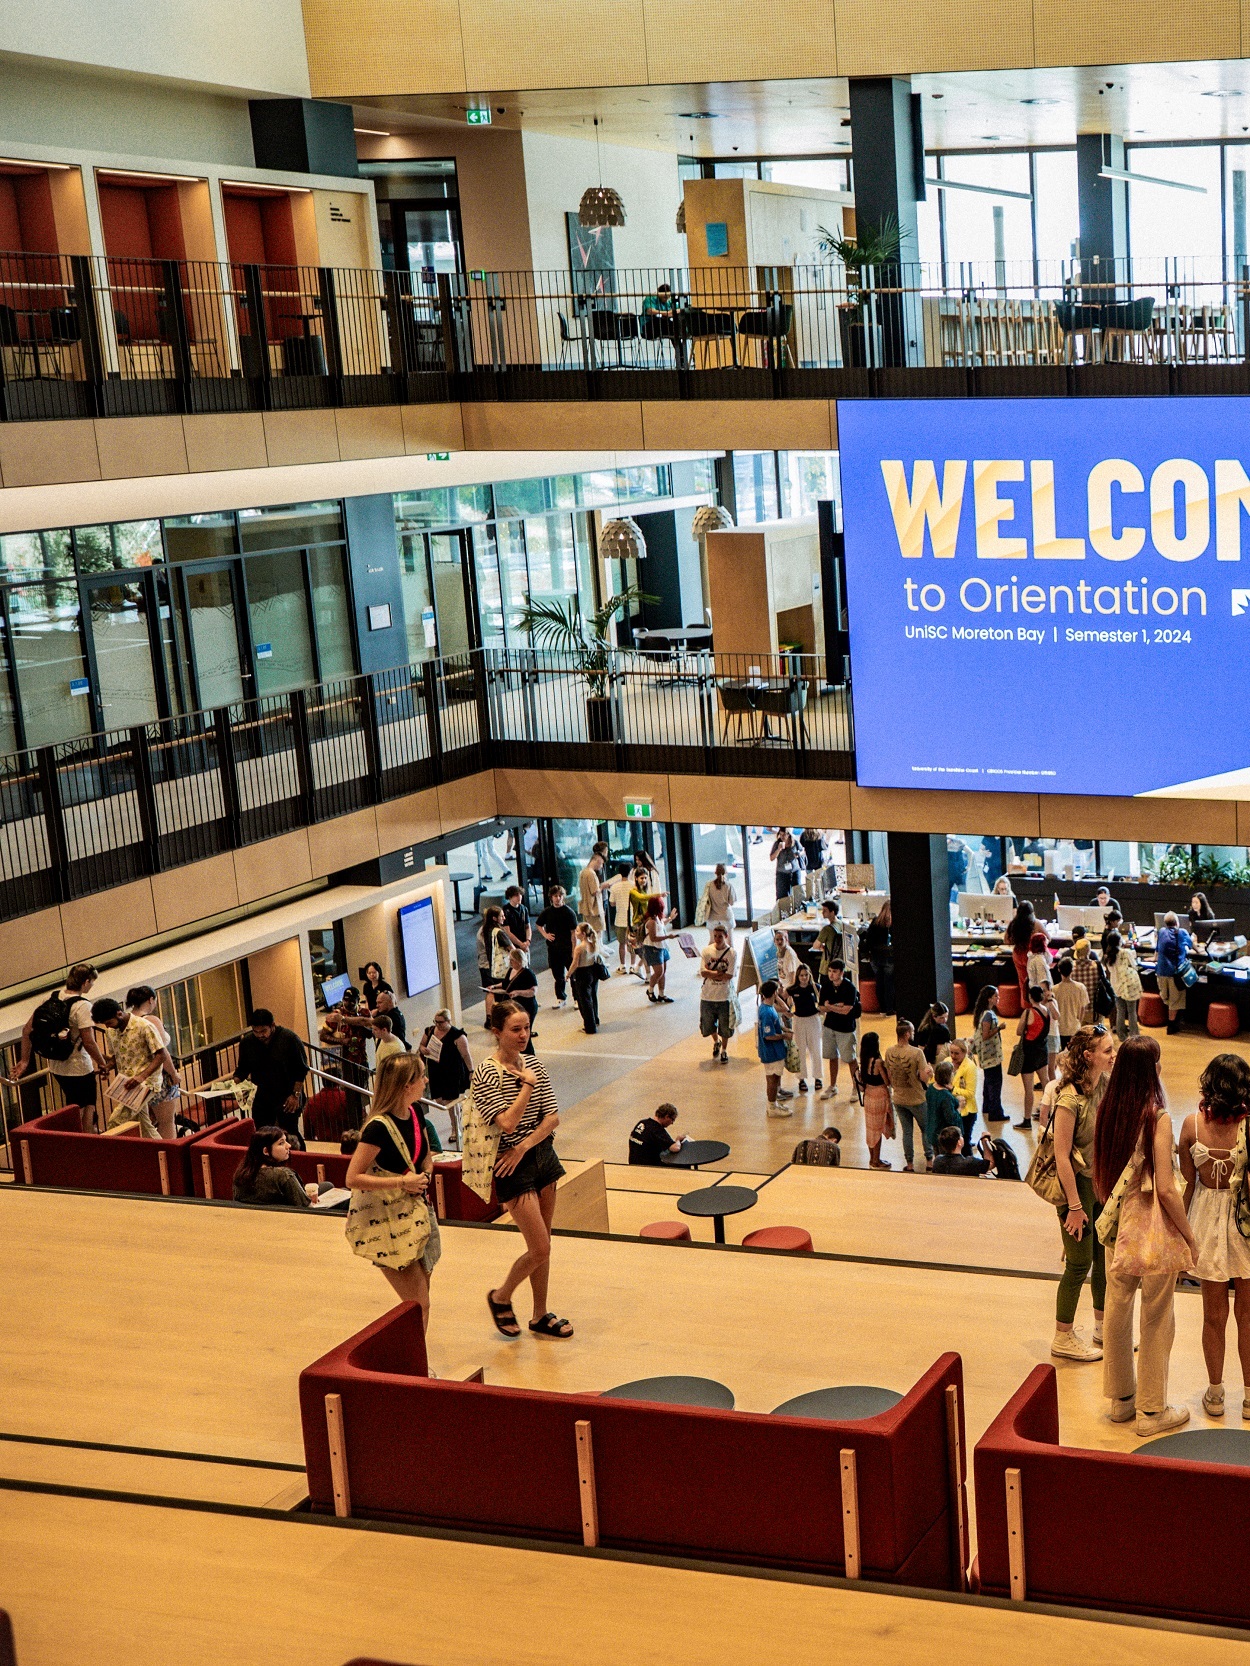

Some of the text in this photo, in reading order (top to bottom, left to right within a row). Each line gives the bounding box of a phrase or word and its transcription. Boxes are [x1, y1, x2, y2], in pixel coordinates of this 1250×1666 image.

[904, 575, 1207, 616] to Orientation
[905, 624, 948, 641] UniSC
[951, 625, 1014, 642] Moreton
[1017, 627, 1045, 645] Bay
[1065, 627, 1138, 644] Semester
[1142, 628, 1151, 646] 1,
[1154, 628, 1192, 645] 2024
